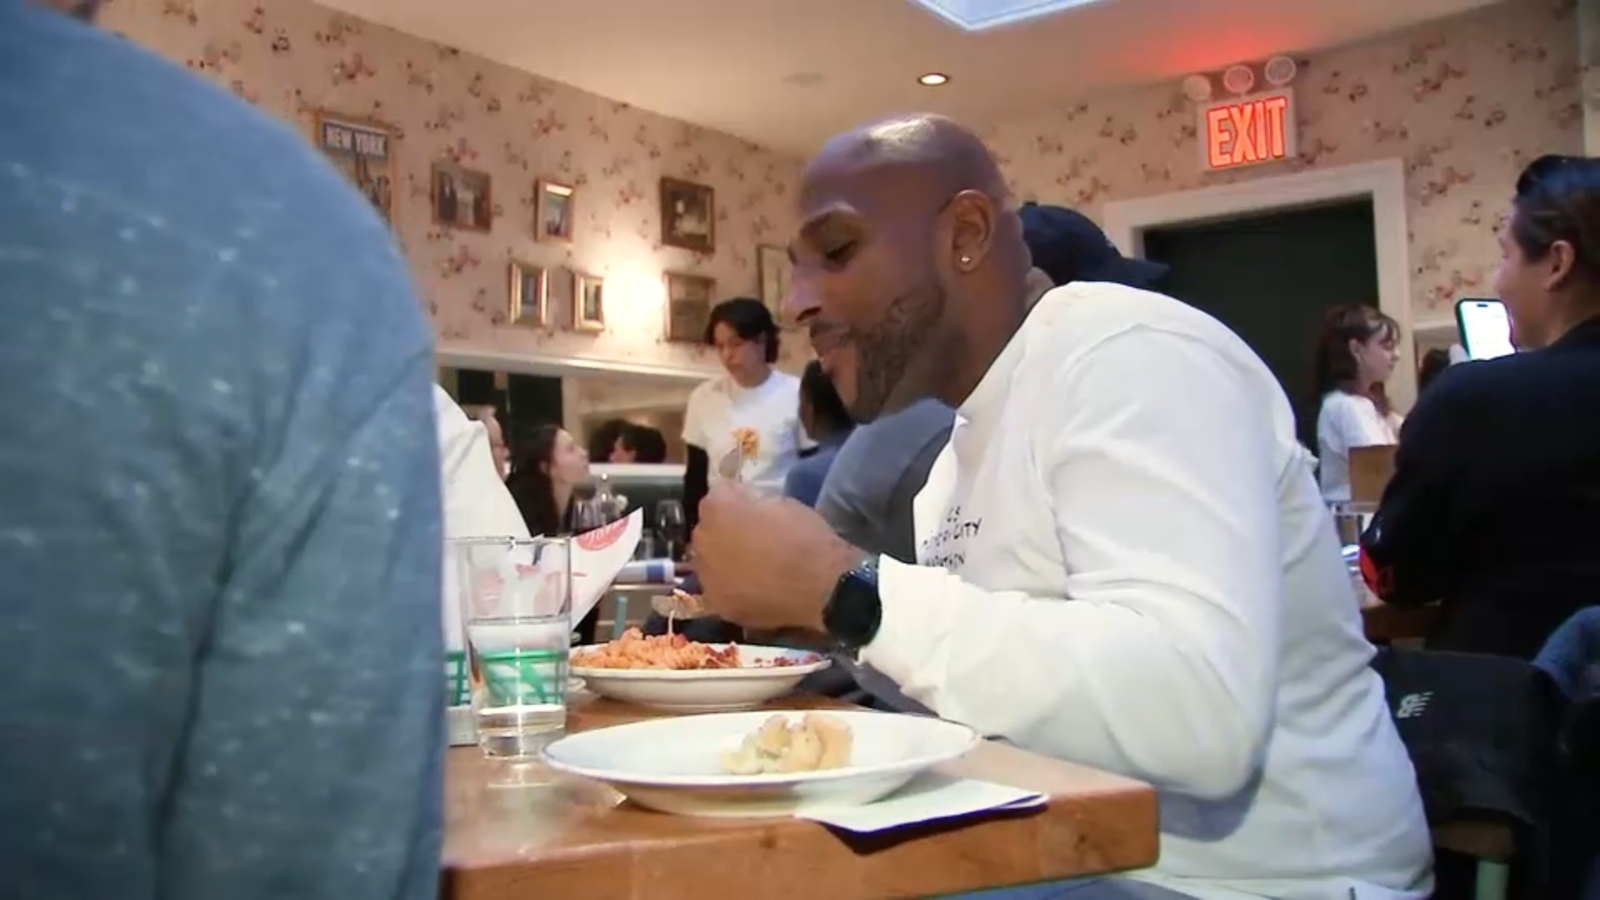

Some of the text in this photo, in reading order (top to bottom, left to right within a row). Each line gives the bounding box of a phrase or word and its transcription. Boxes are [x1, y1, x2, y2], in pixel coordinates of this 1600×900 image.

[326, 124, 387, 156] NEW YORK
[1208, 97, 1286, 167] EXIT
[953, 517, 982, 540] CITY
